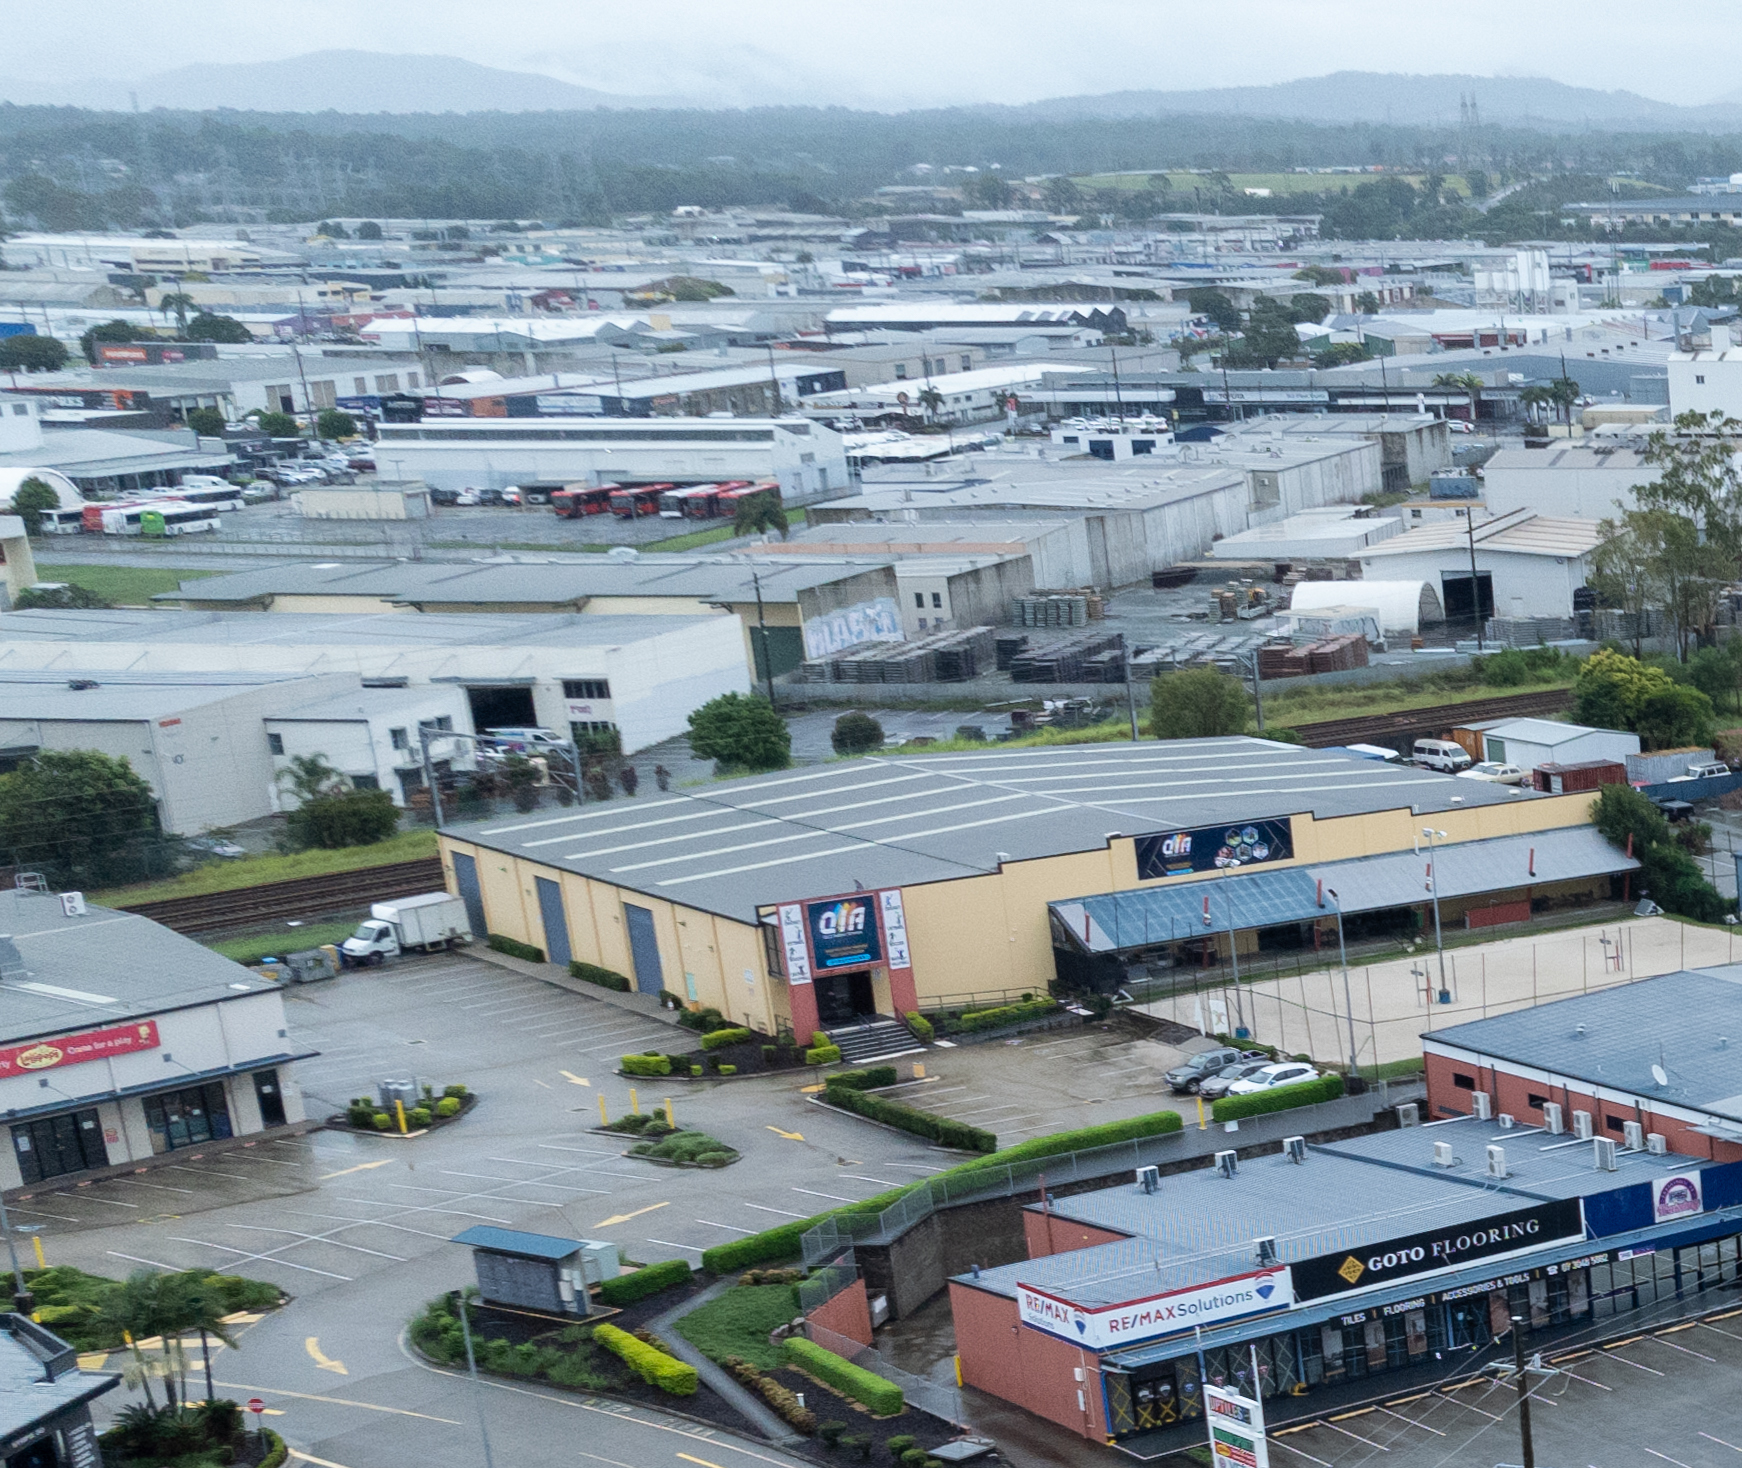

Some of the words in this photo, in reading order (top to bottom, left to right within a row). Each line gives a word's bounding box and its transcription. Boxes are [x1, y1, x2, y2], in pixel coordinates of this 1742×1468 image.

[1367, 1246, 1426, 1271] GOTO
[1431, 1218, 1541, 1258] FLOORING
[1025, 1293, 1070, 1325] RE/MAX
[1341, 1312, 1367, 1326] TILES
[1383, 1298, 1426, 1316] FLOORING
[1441, 1281, 1496, 1302] ACCESSORIES
[1504, 1272, 1531, 1287] TOOLS
